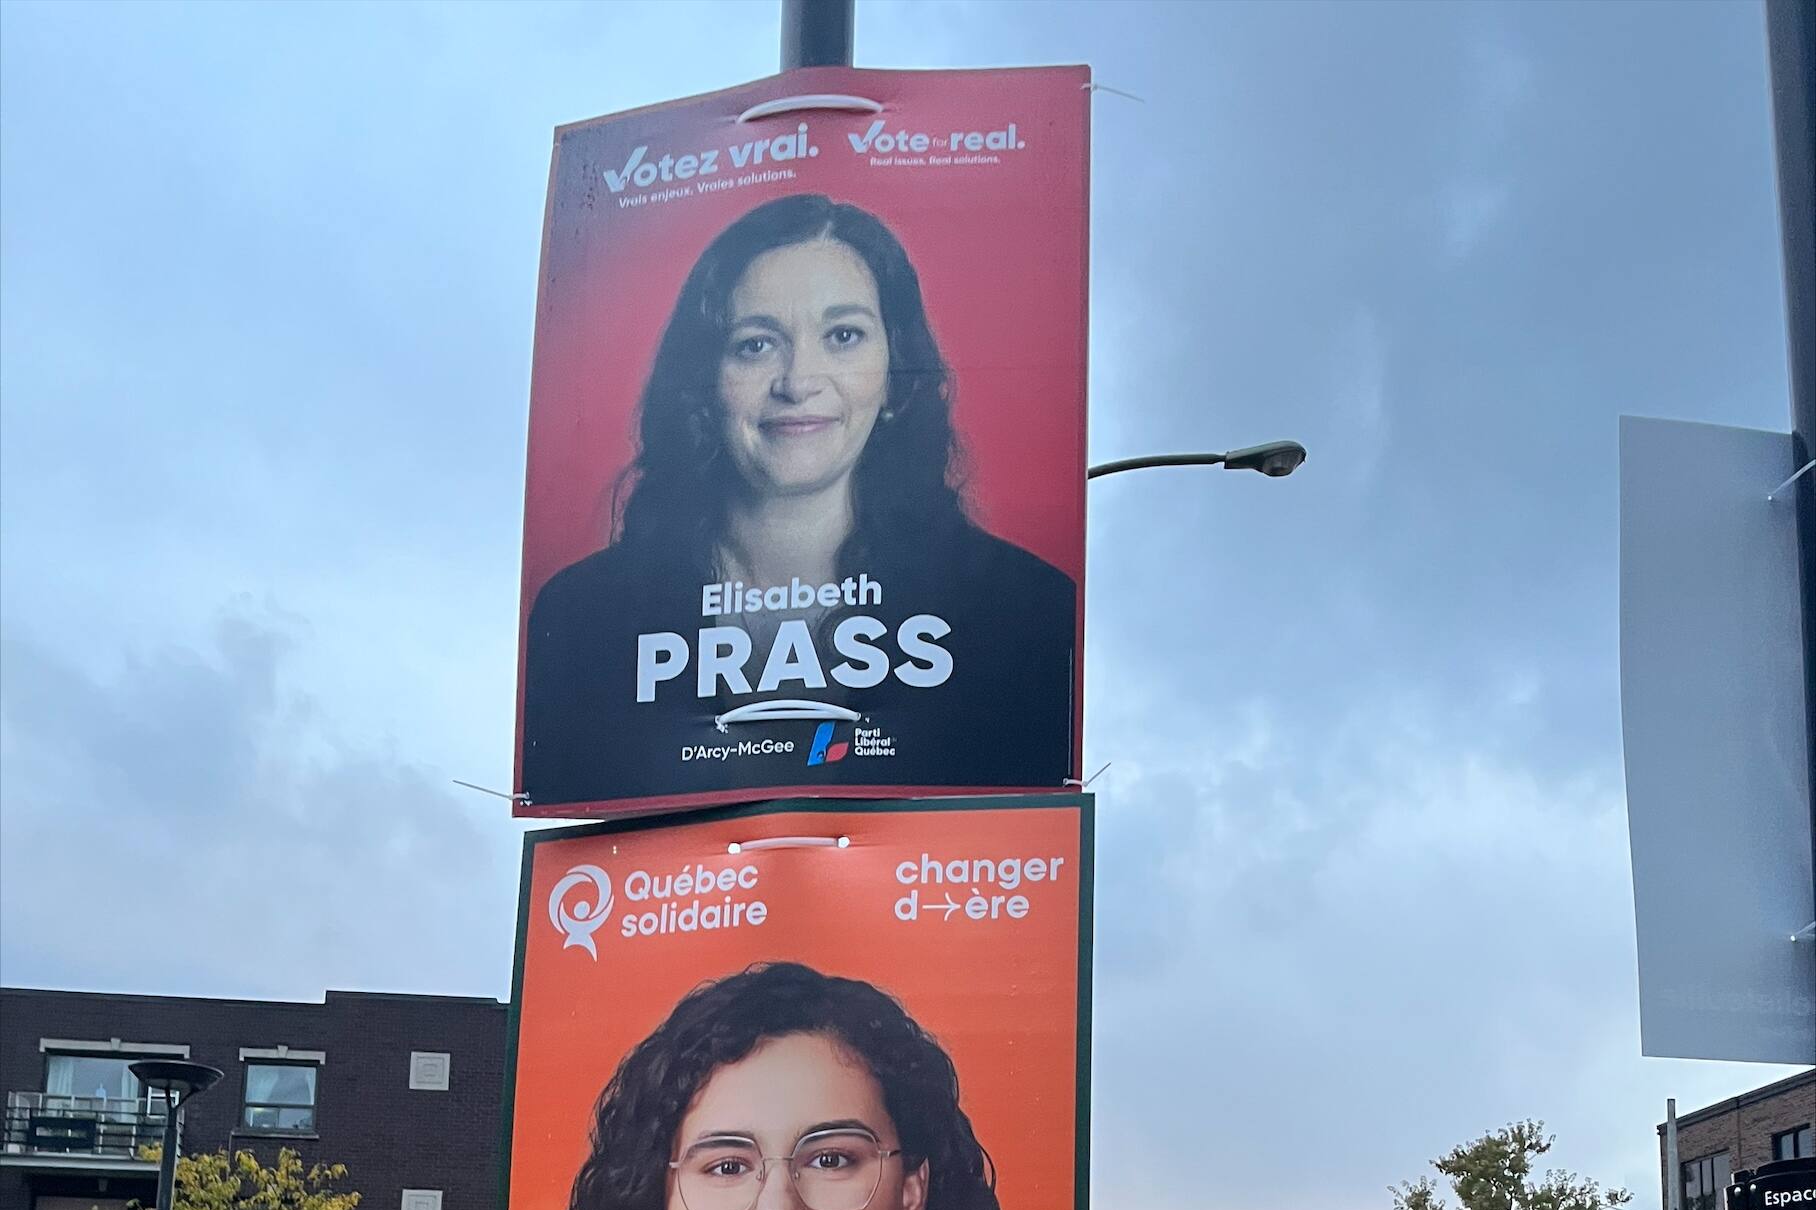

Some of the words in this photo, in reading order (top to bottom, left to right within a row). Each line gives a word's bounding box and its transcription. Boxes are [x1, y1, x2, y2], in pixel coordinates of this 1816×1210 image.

[847, 119, 930, 154] Vote
[931, 137, 949, 148] for
[950, 122, 1026, 151] real.
[603, 145, 719, 193] Votez
[728, 122, 820, 168] vrai.
[618, 195, 648, 209] Vrais
[650, 186, 694, 203] enjeux.
[697, 179, 735, 194] Vraies
[737, 168, 797, 187] solutions.
[701, 573, 882, 617] Elisabeth
[636, 613, 954, 703] PRASS
[681, 738, 795, 761] D'Arcy-McGee
[854, 727, 881, 738] Parti
[854, 736, 891, 747] Libéral
[854, 745, 896, 756] Québec
[624, 863, 759, 901] Québec
[895, 853, 1065, 890] changer
[620, 895, 768, 938] solidaire
